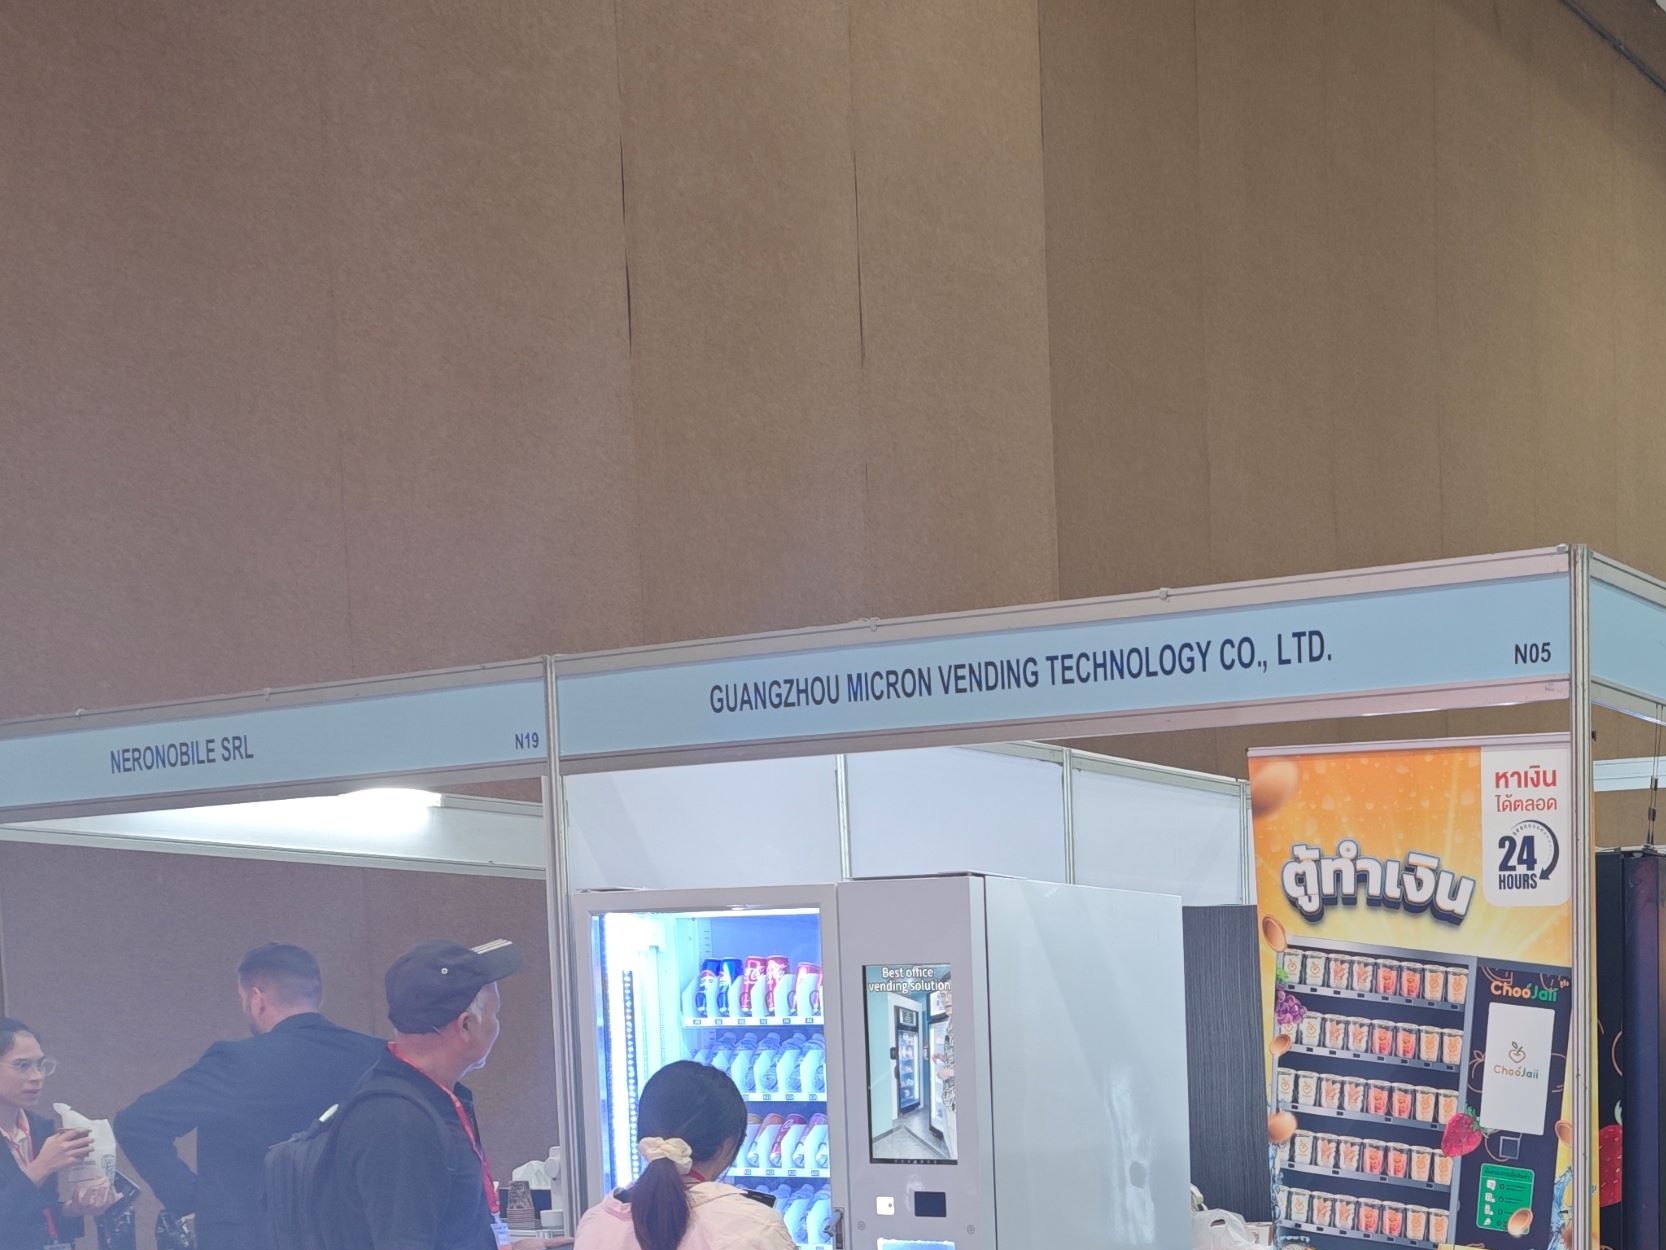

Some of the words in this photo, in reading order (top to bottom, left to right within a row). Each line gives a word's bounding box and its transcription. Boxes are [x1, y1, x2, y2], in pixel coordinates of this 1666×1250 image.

[1514, 642, 1552, 665] N05
[710, 673, 840, 713] GUANGZHOU
[847, 667, 932, 703] MICRON
[938, 656, 1040, 695] VENDING
[1046, 640, 1212, 686] TECHNOLOGY
[1219, 636, 1268, 673] CO.,
[1277, 630, 1332, 665] LTD.
[514, 732, 540, 751] N19
[110, 738, 216, 774] NERONOBILE
[221, 734, 254, 762] SRL
[1495, 765, 1558, 789] หาเงิน
[1495, 794, 1558, 813] ได้ตลอด
[1498, 835, 1537, 872] 24
[1281, 838, 1477, 926] ตู้ทำเงิน
[1498, 873, 1538, 890] HOURS
[882, 967, 904, 978] Best
[905, 967, 934, 978] office
[868, 980, 909, 994] vending
[909, 979, 951, 992] solution
